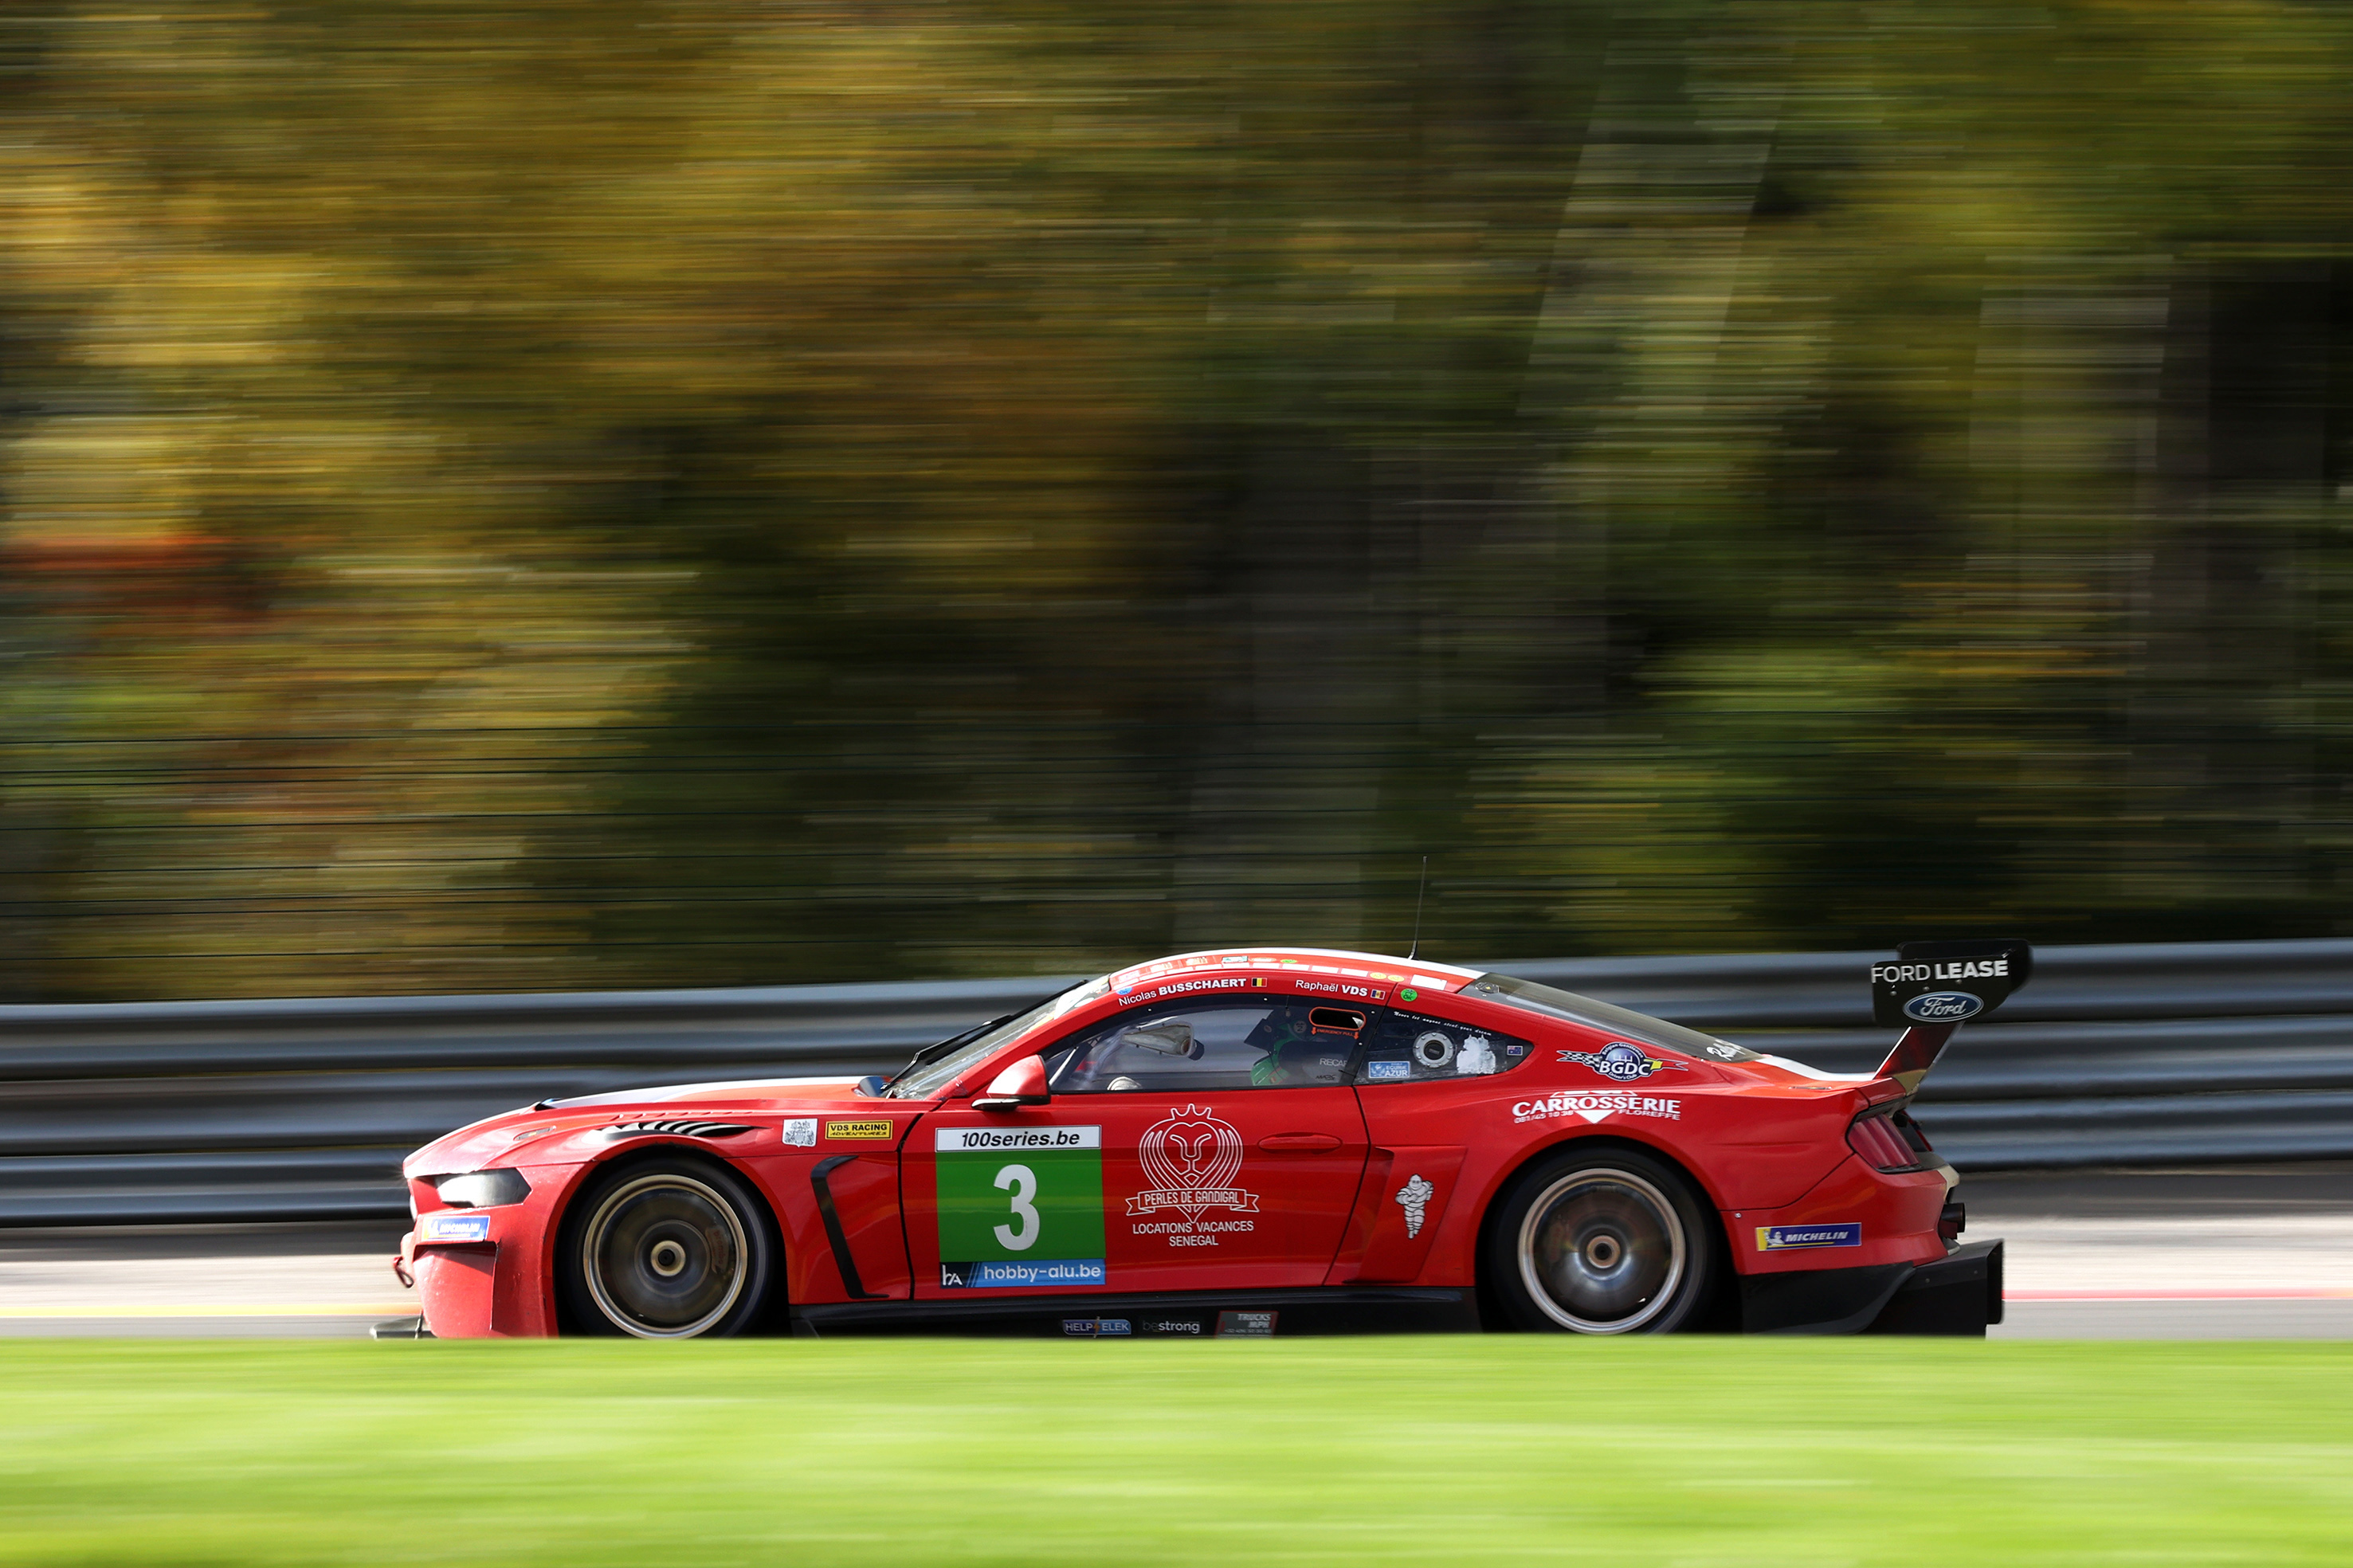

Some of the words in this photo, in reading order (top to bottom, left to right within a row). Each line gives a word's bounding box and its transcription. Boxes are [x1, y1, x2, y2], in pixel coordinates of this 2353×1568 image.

[1871, 964, 1931, 983] FORD
[1935, 960, 2009, 980] LEASE
[1119, 990, 1157, 1006] Nicolas
[1159, 978, 1246, 996] BUSSCHAERT
[1296, 979, 1339, 992] Raphaël
[1342, 985, 1368, 997] VDS
[1920, 997, 1967, 1016] Ford
[1601, 1044, 1618, 1056] Belgian
[1619, 1042, 1644, 1058] Gentlemen
[1599, 1060, 1651, 1076] BGDC
[1608, 1071, 1626, 1080] Driver's
[1512, 1096, 1680, 1116] CARROSSERIE
[1618, 1108, 1680, 1121] FLOREFFE
[962, 1131, 1080, 1147] 100series.be
[1144, 1192, 1178, 1205] PERLES
[1181, 1191, 1193, 1203] DE
[1195, 1190, 1239, 1204] GANDIGAL
[993, 1164, 1040, 1251] 3
[1133, 1222, 1192, 1234] LOCATIONS
[1196, 1221, 1254, 1232] VACANCES
[1169, 1235, 1219, 1247] SENEGAL
[1785, 1231, 1849, 1242] MICHELIN
[984, 1264, 1101, 1283] hobby-alu.be
[1065, 1323, 1093, 1331] HELP
[1102, 1323, 1129, 1331] ELEK
[1143, 1320, 1200, 1334] bestrong
